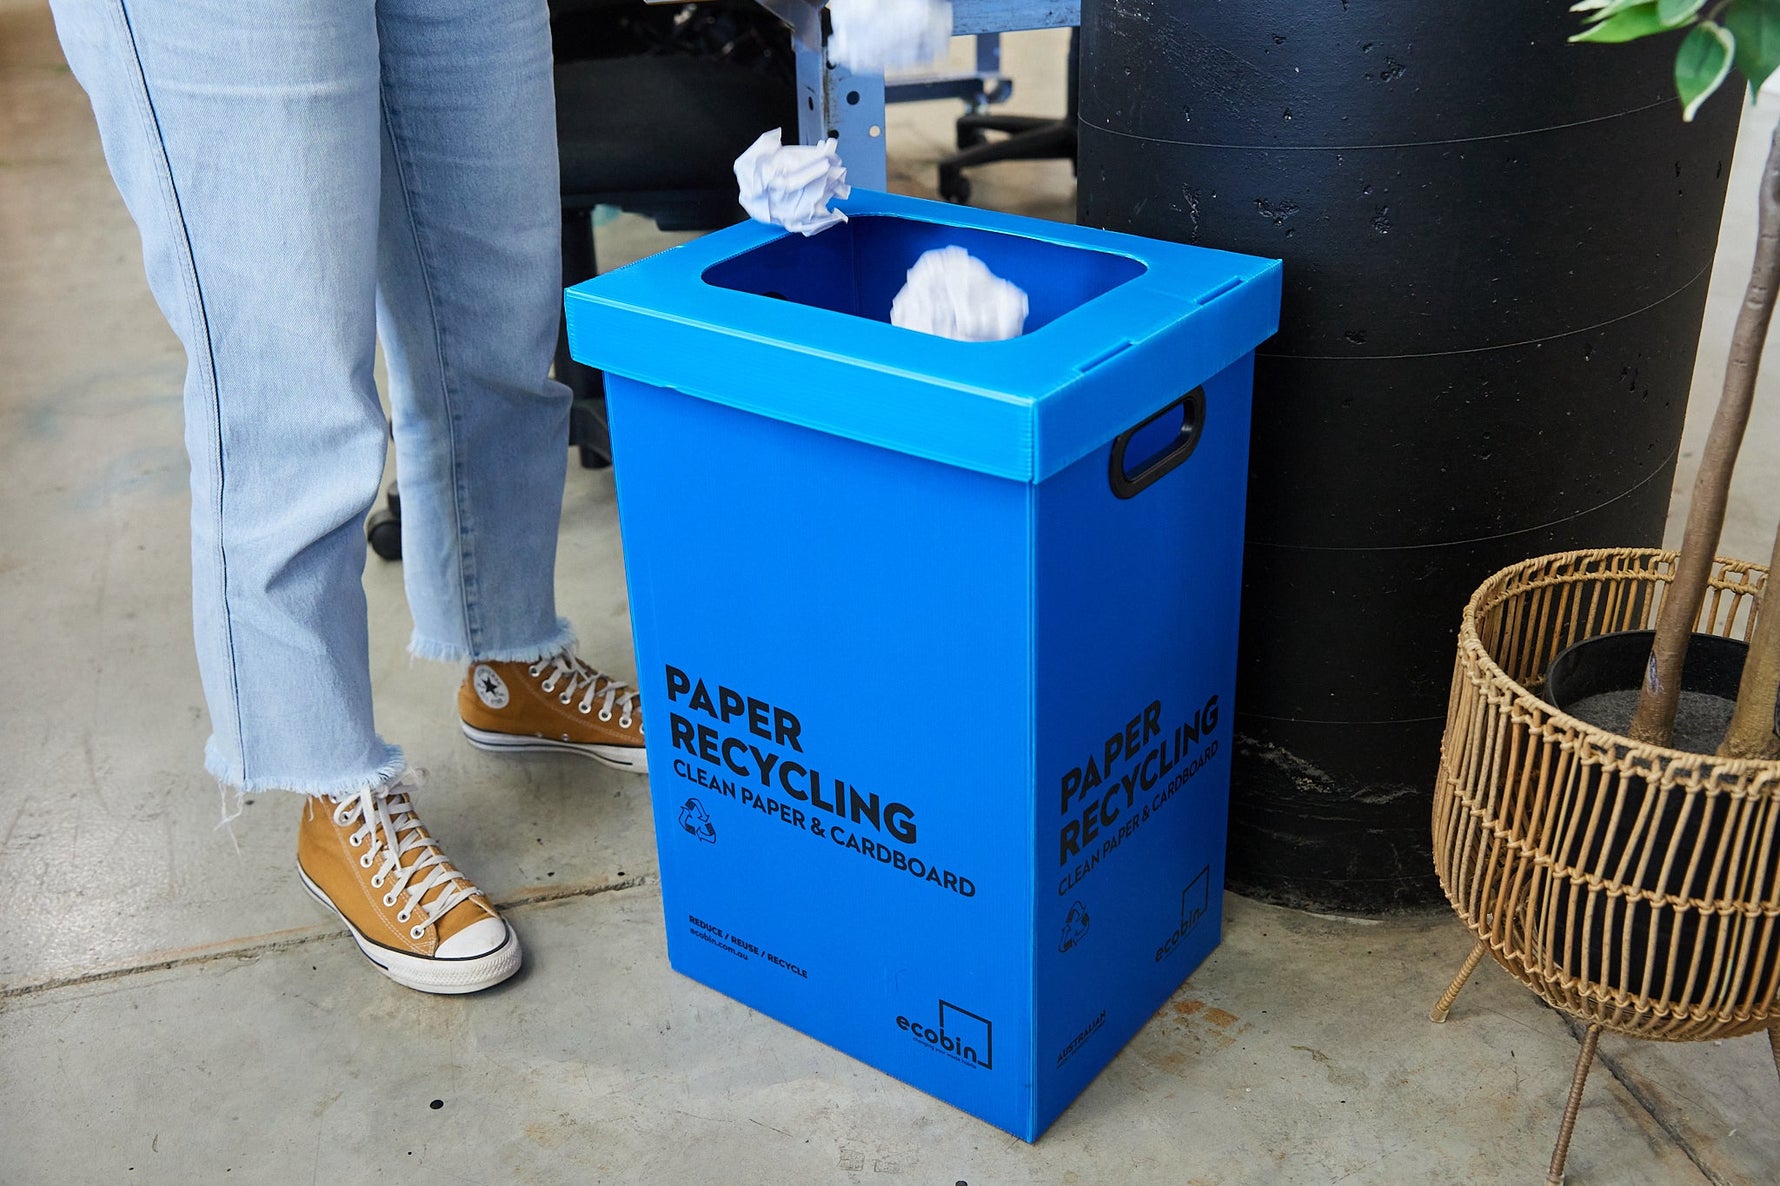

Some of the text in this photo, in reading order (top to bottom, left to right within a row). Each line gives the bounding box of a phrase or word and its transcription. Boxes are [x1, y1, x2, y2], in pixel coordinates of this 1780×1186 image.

[665, 664, 803, 753] PAPER
[669, 712, 917, 845] RECYCLING
[1060, 694, 1219, 868] RECYCLING
[1061, 700, 1162, 816] PAPER
[673, 758, 976, 898] CLEAN PAPER & CARDBOARD
[1058, 739, 1219, 897] CLEAN PAPER & CARDBOARD
[688, 914, 723, 938] REDUCE
[730, 935, 760, 956] REUSE
[767, 953, 808, 979] RECYCLE
[690, 927, 749, 961] ecobin.com.au
[1155, 908, 1201, 963] ecobin
[896, 1015, 977, 1064] ecobin
[1057, 1008, 1106, 1063] AUSTRALIAN
